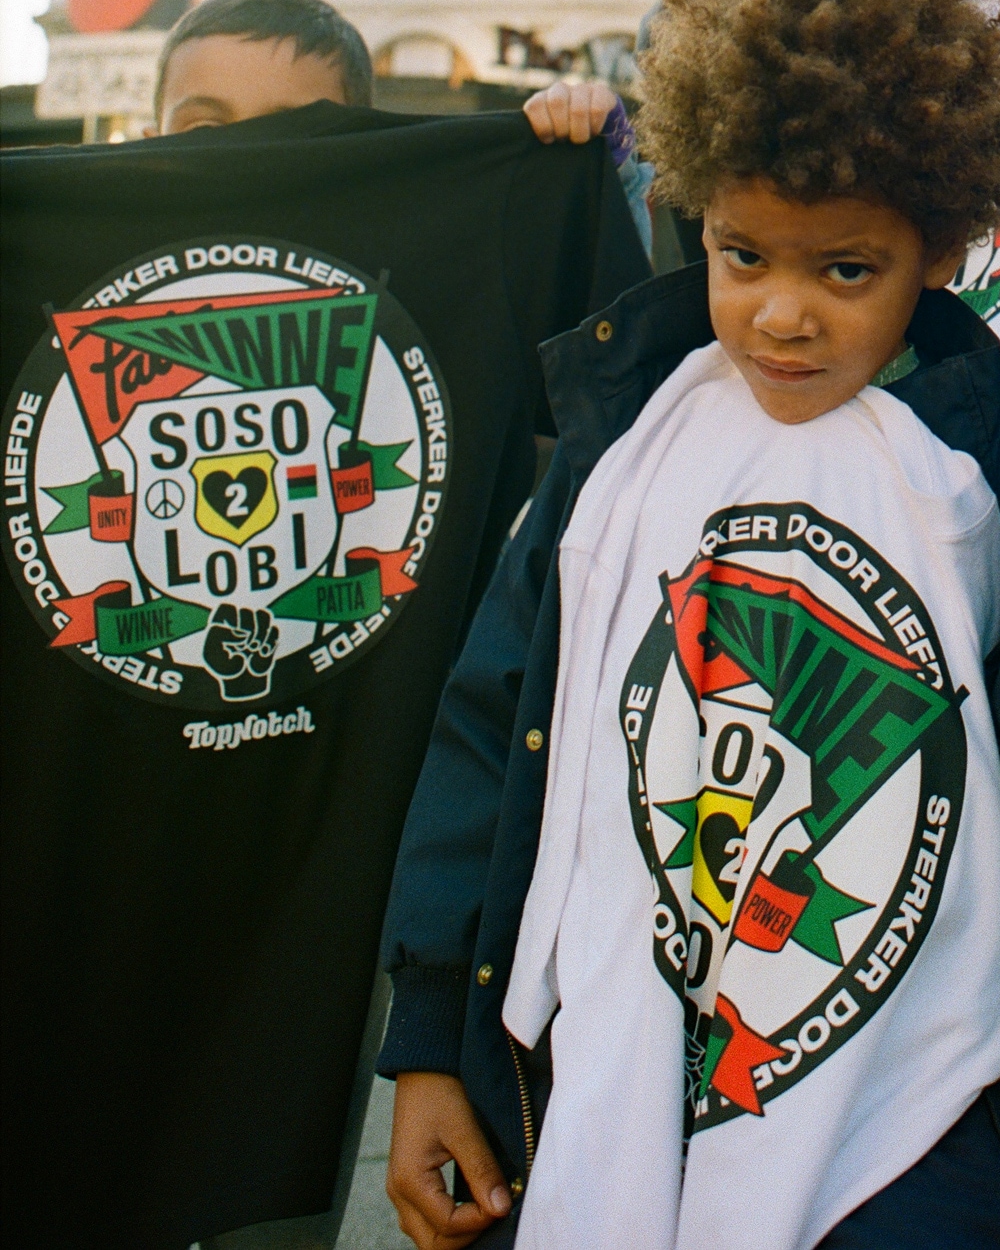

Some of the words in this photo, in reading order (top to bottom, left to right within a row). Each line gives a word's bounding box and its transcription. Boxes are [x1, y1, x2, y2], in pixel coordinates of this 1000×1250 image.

[81, 254, 180, 310] RKER
[185, 243, 278, 271] DOOR
[284, 252, 366, 295] LIEF
[149, 398, 309, 470] SOSO
[403, 346, 447, 483] STERKER
[4, 390, 43, 507] LIEFDE
[97, 508, 128, 530] UNITY
[224, 482, 250, 518] 2
[336, 476, 370, 499] POWER
[8, 511, 60, 608] DOOR
[164, 513, 308, 596] LOBI
[115, 606, 175, 647] WINNE
[316, 581, 366, 617] PATTA
[698, 514, 778, 558] RKER
[786, 513, 880, 593] DOOR
[873, 587, 944, 691] LIEF
[308, 603, 392, 674] IEFDE
[182, 706, 316, 751] TopNotch
[717, 836, 744, 885] 2
[853, 794, 951, 993] STERKER
[743, 893, 794, 938] POWER
